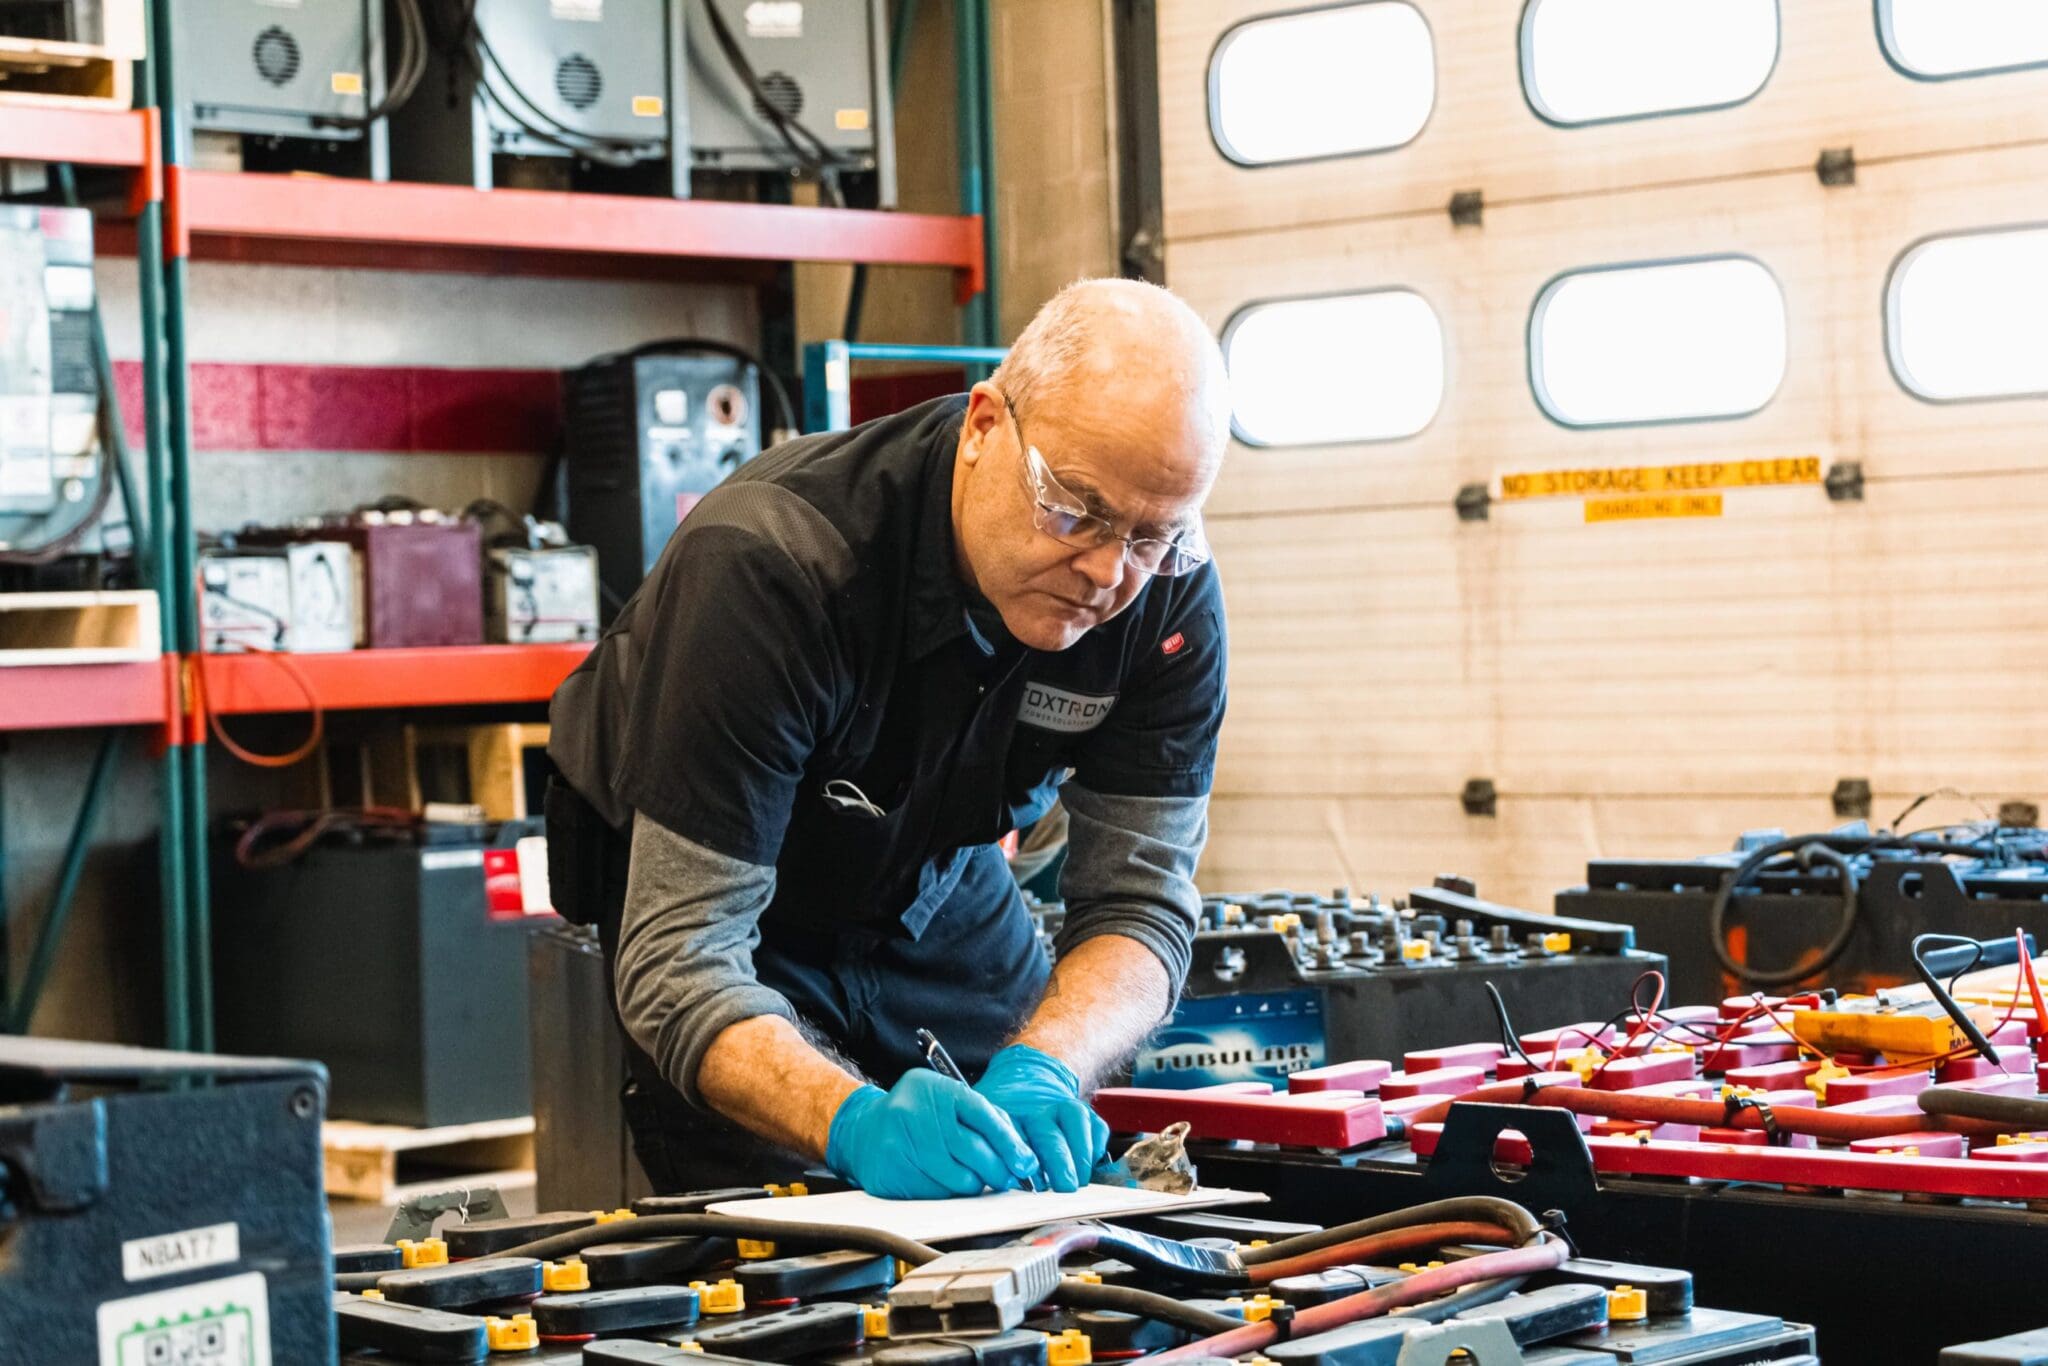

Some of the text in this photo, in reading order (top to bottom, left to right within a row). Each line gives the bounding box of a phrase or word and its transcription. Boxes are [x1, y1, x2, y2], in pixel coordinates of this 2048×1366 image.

[1502, 456, 1820, 498] NO STORAGE KEEP CLEAR
[1024, 687, 1113, 719] OXTRON
[1154, 1044, 1311, 1073] TUBULAR
